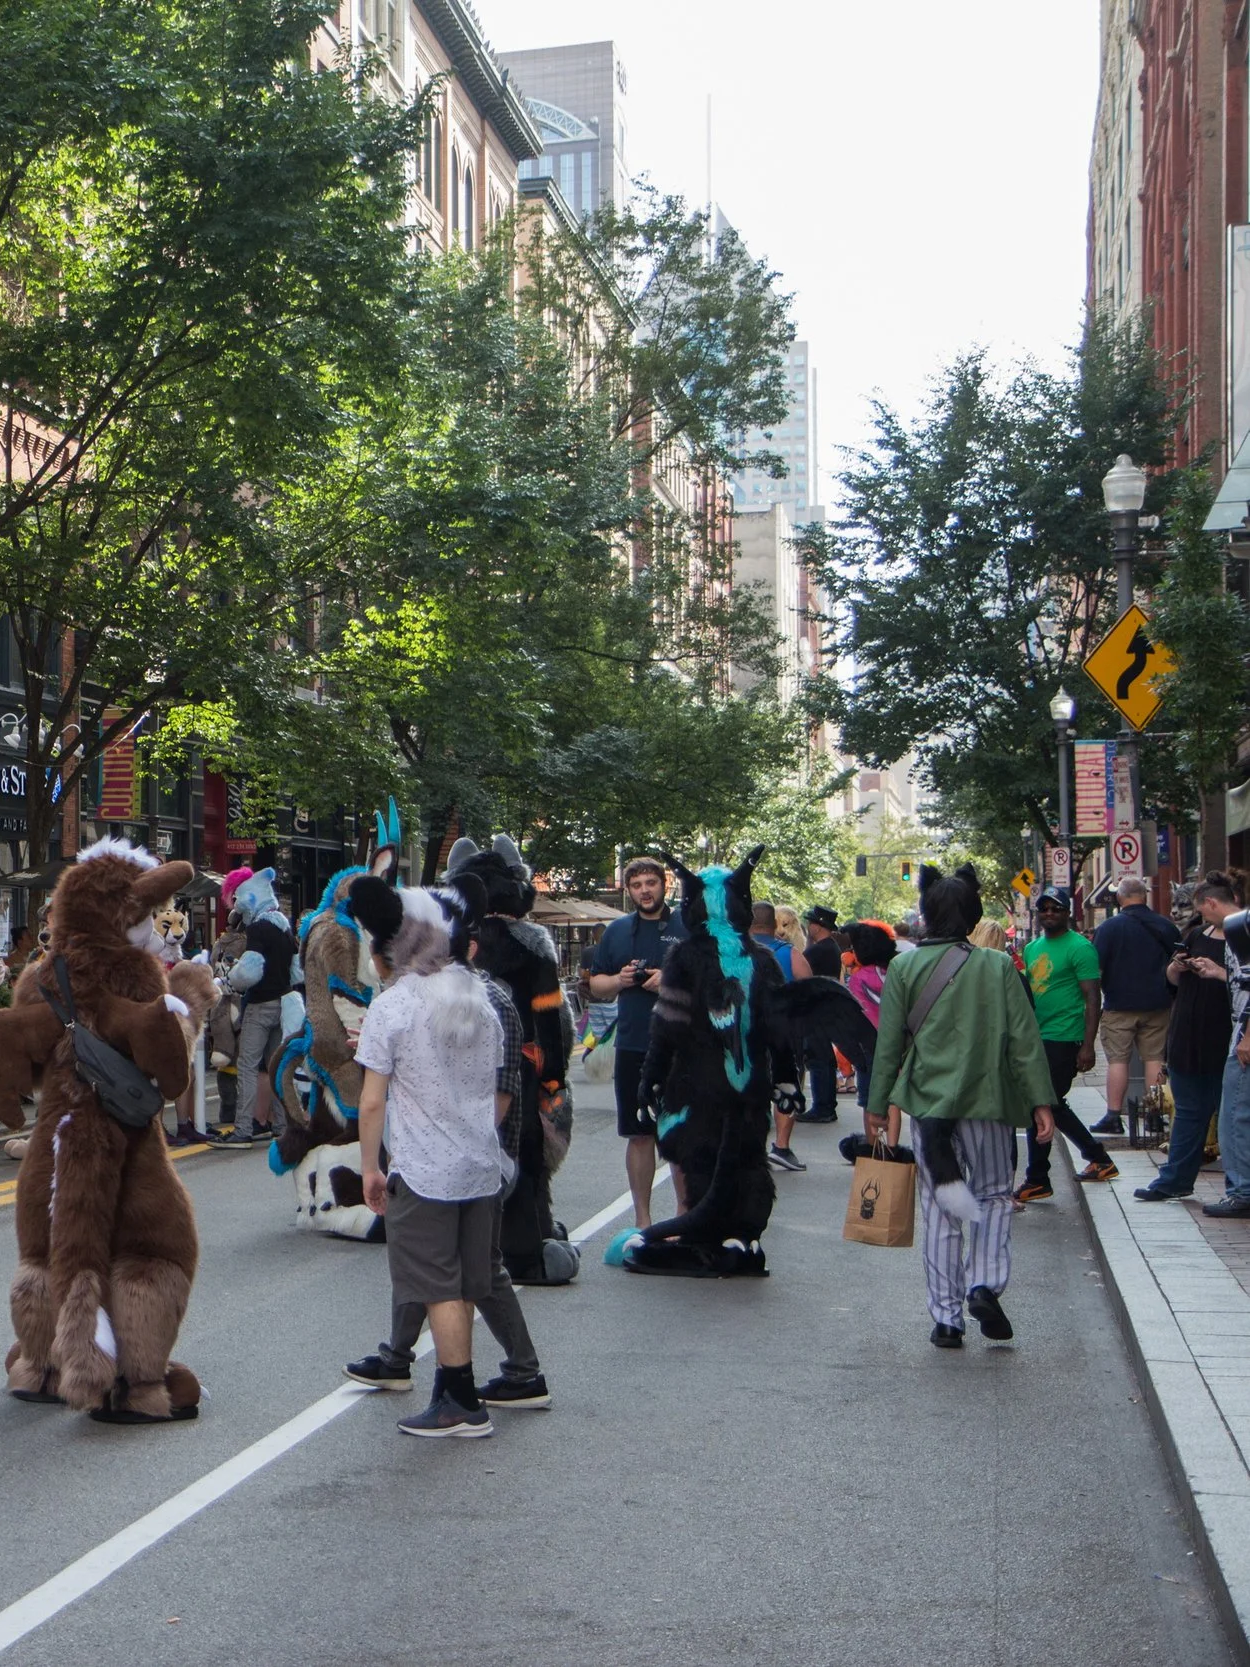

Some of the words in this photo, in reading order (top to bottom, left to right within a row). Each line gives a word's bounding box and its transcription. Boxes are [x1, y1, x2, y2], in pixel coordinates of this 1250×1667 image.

[1, 768, 9, 793] &
[1075, 745, 1107, 834] CULTURAL
[3, 818, 18, 831] AND
